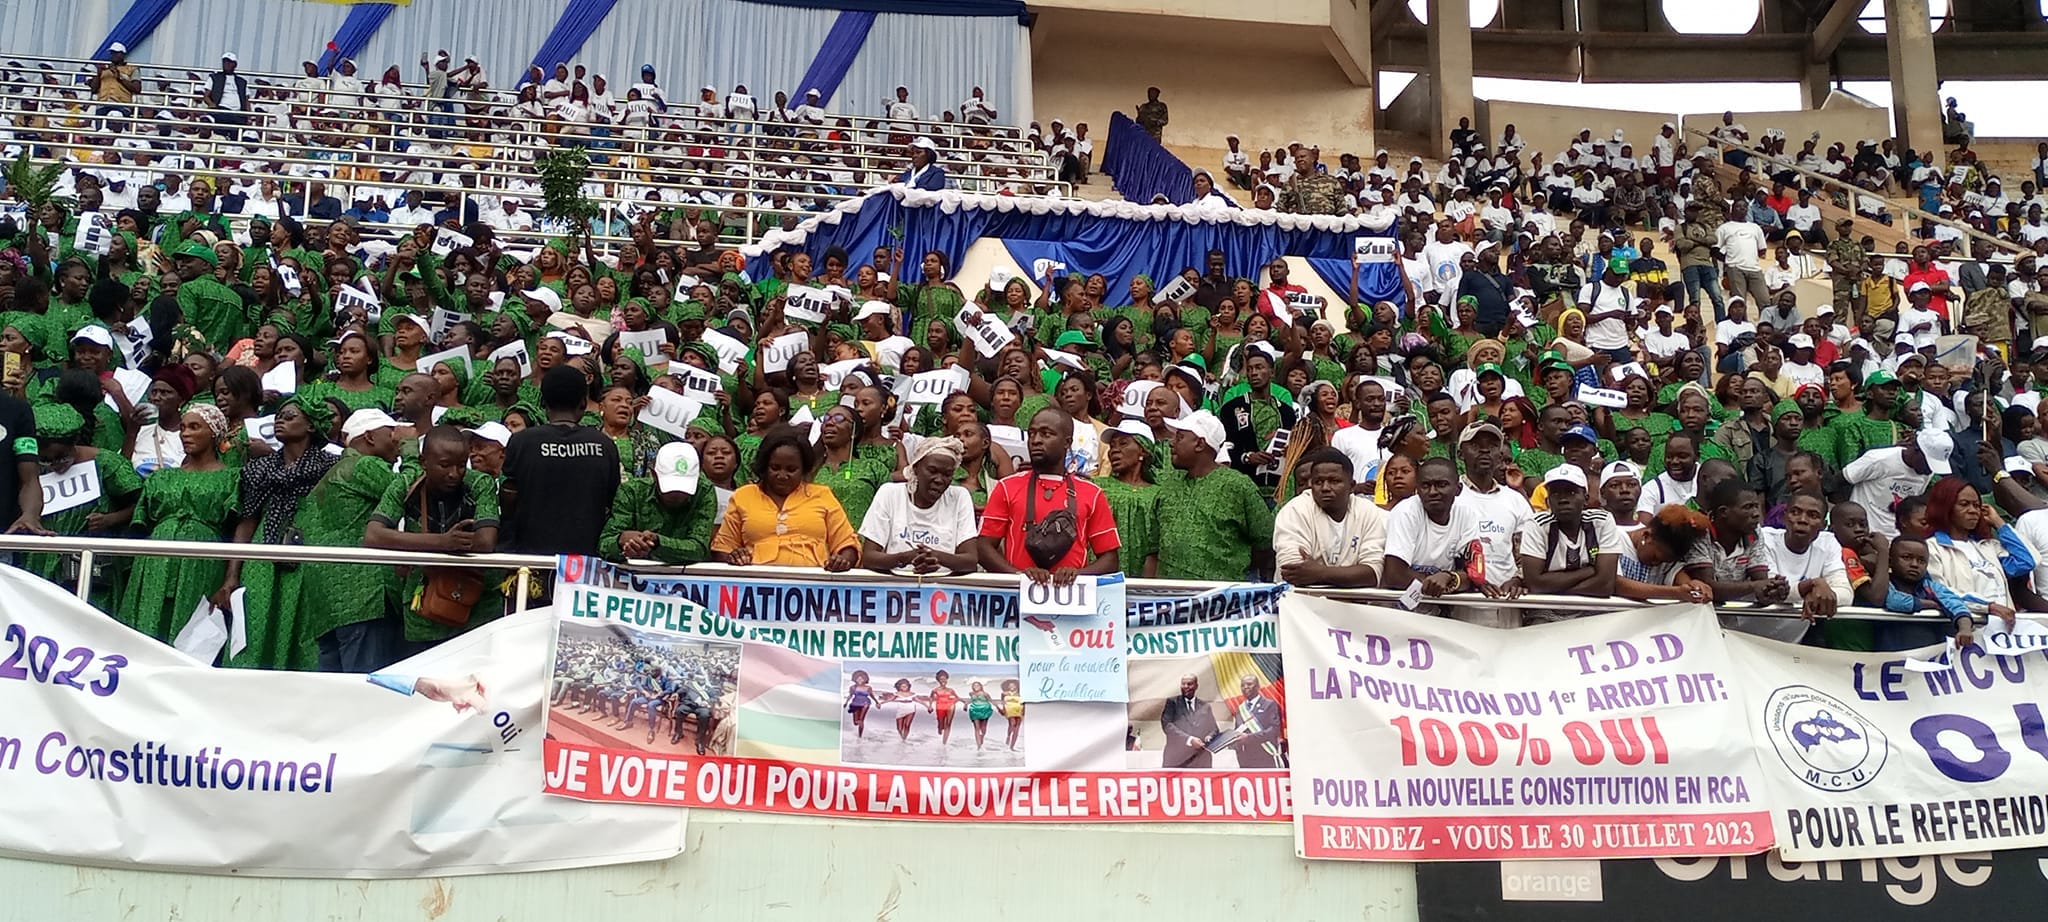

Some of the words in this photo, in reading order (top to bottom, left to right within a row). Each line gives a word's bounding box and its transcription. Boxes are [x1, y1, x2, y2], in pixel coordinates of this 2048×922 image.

[540, 442, 603, 458] SECURITE
[719, 585, 876, 624] NATIONALE
[886, 591, 921, 624] DE
[1028, 581, 1089, 606] OUI
[572, 591, 600, 618] LE
[606, 594, 694, 633] PEUPLE
[833, 631, 938, 659] RECLAME
[945, 633, 990, 661] UNE
[1069, 622, 1115, 649] oui
[0, 624, 128, 697] 2023
[1028, 660, 1055, 677] pour
[1059, 656, 1070, 672] la
[1074, 656, 1120, 673] nouvelle
[1328, 628, 1434, 670] T.D.D
[1568, 633, 1684, 675] T.D.D
[1038, 676, 1107, 699] République
[1309, 667, 1343, 699] LA
[1349, 670, 1502, 716] POPULATION
[1504, 692, 1542, 716] DU
[1548, 690, 1576, 715] 1er
[1587, 675, 1670, 712] ARRDT
[1676, 673, 1729, 704] DIT:
[1853, 660, 1909, 700] LE
[493, 711, 523, 744] oui
[1391, 715, 1551, 767] 100%
[1562, 716, 1669, 766] OUI
[35, 732, 337, 793] Constitutionnel
[547, 748, 590, 792] JE
[599, 753, 688, 800] VOTE
[696, 761, 756, 806] OUI
[765, 766, 858, 811] POUR
[868, 772, 910, 814] LA
[918, 776, 1089, 817] NOUVELLE
[1098, 776, 1293, 819] REPUBLIQUE
[1313, 778, 1369, 808] POUR
[1374, 779, 1402, 808] LA
[1407, 777, 1514, 807] NOUVELLE
[1521, 776, 1668, 806] CONSTITUTION
[1675, 775, 1702, 804] EN
[1708, 775, 1751, 803] RCA
[1320, 824, 1425, 851] RENDEZ
[1446, 824, 1514, 850] VOUS
[1519, 823, 1553, 849] LE
[1560, 823, 1585, 849] 30
[1592, 822, 1696, 849] JUILLET
[1703, 820, 1755, 846] 2023
[1787, 806, 1865, 849] POUR
[1868, 804, 1905, 846] LE
[1506, 873, 1592, 897] orange
